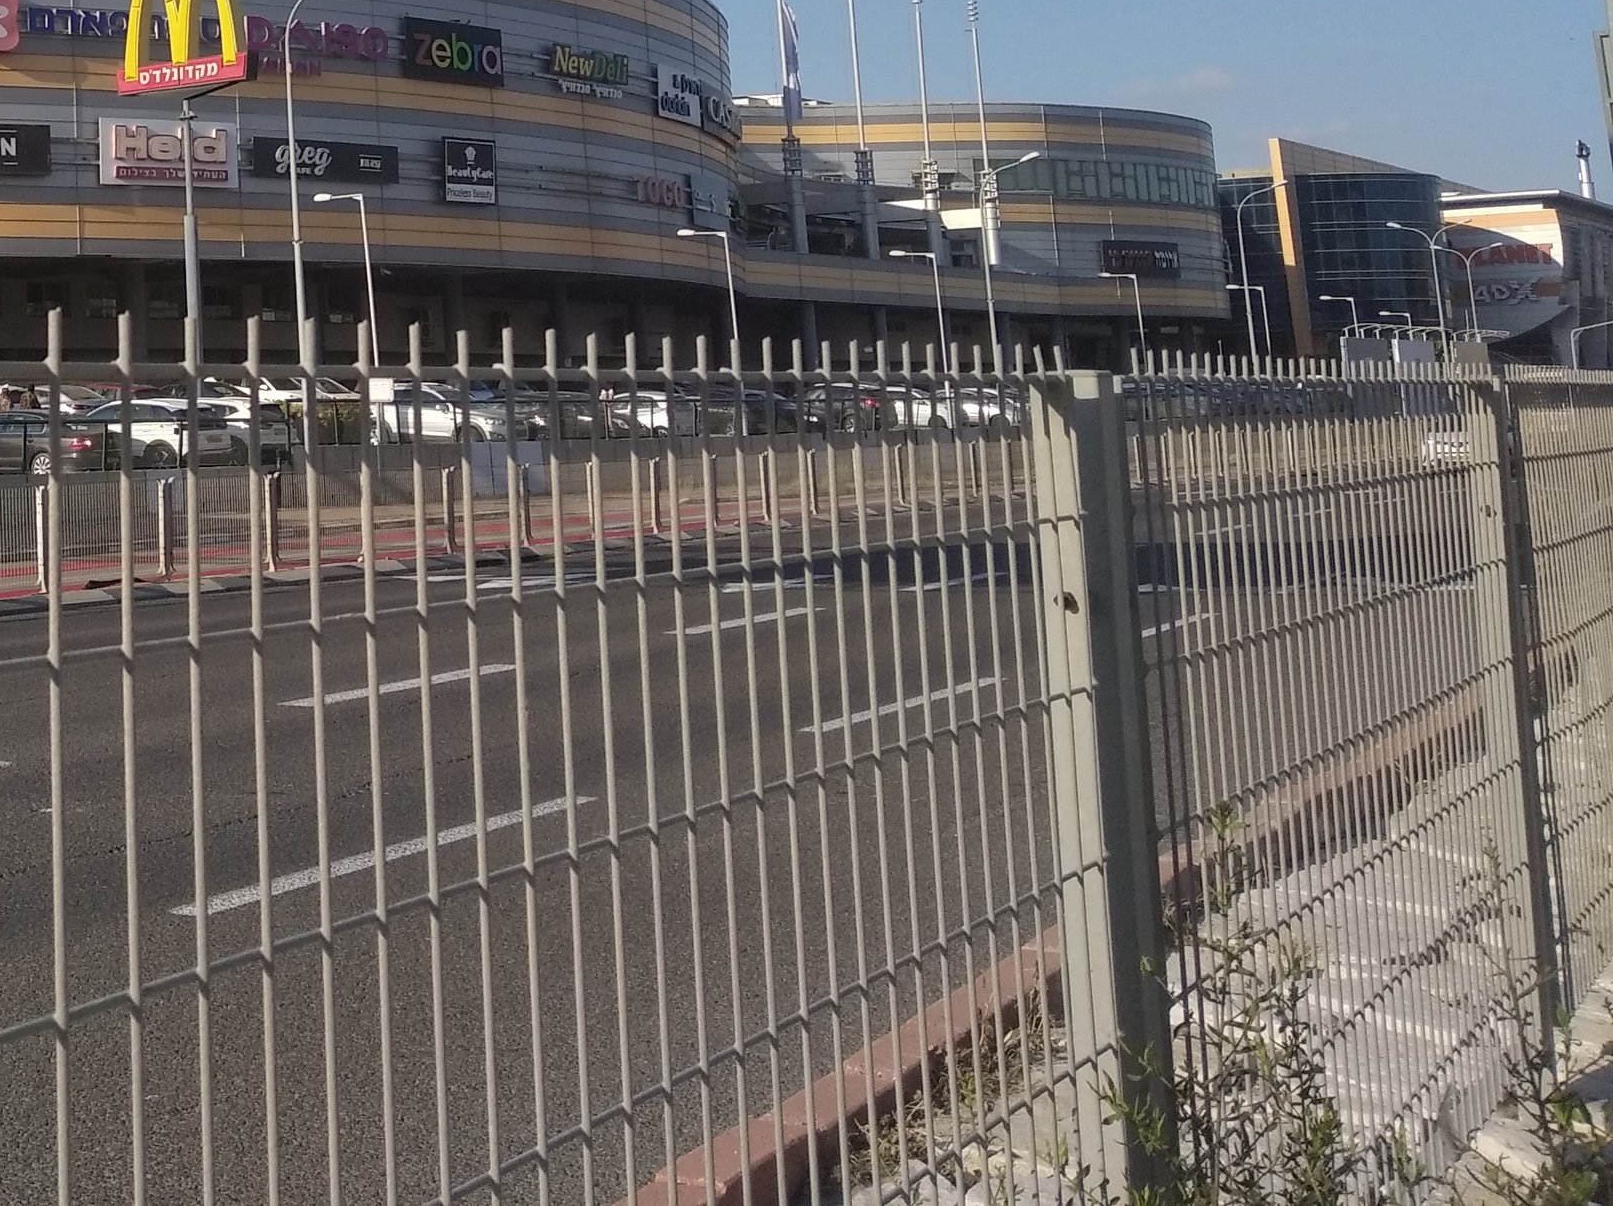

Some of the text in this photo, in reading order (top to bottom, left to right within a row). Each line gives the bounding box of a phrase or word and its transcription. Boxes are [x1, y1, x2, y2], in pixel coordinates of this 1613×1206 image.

[413, 32, 502, 74] zebra
[139, 61, 219, 86] מקדונלד'ס
[119, 167, 157, 177] בצילום
[163, 168, 187, 179] שלך
